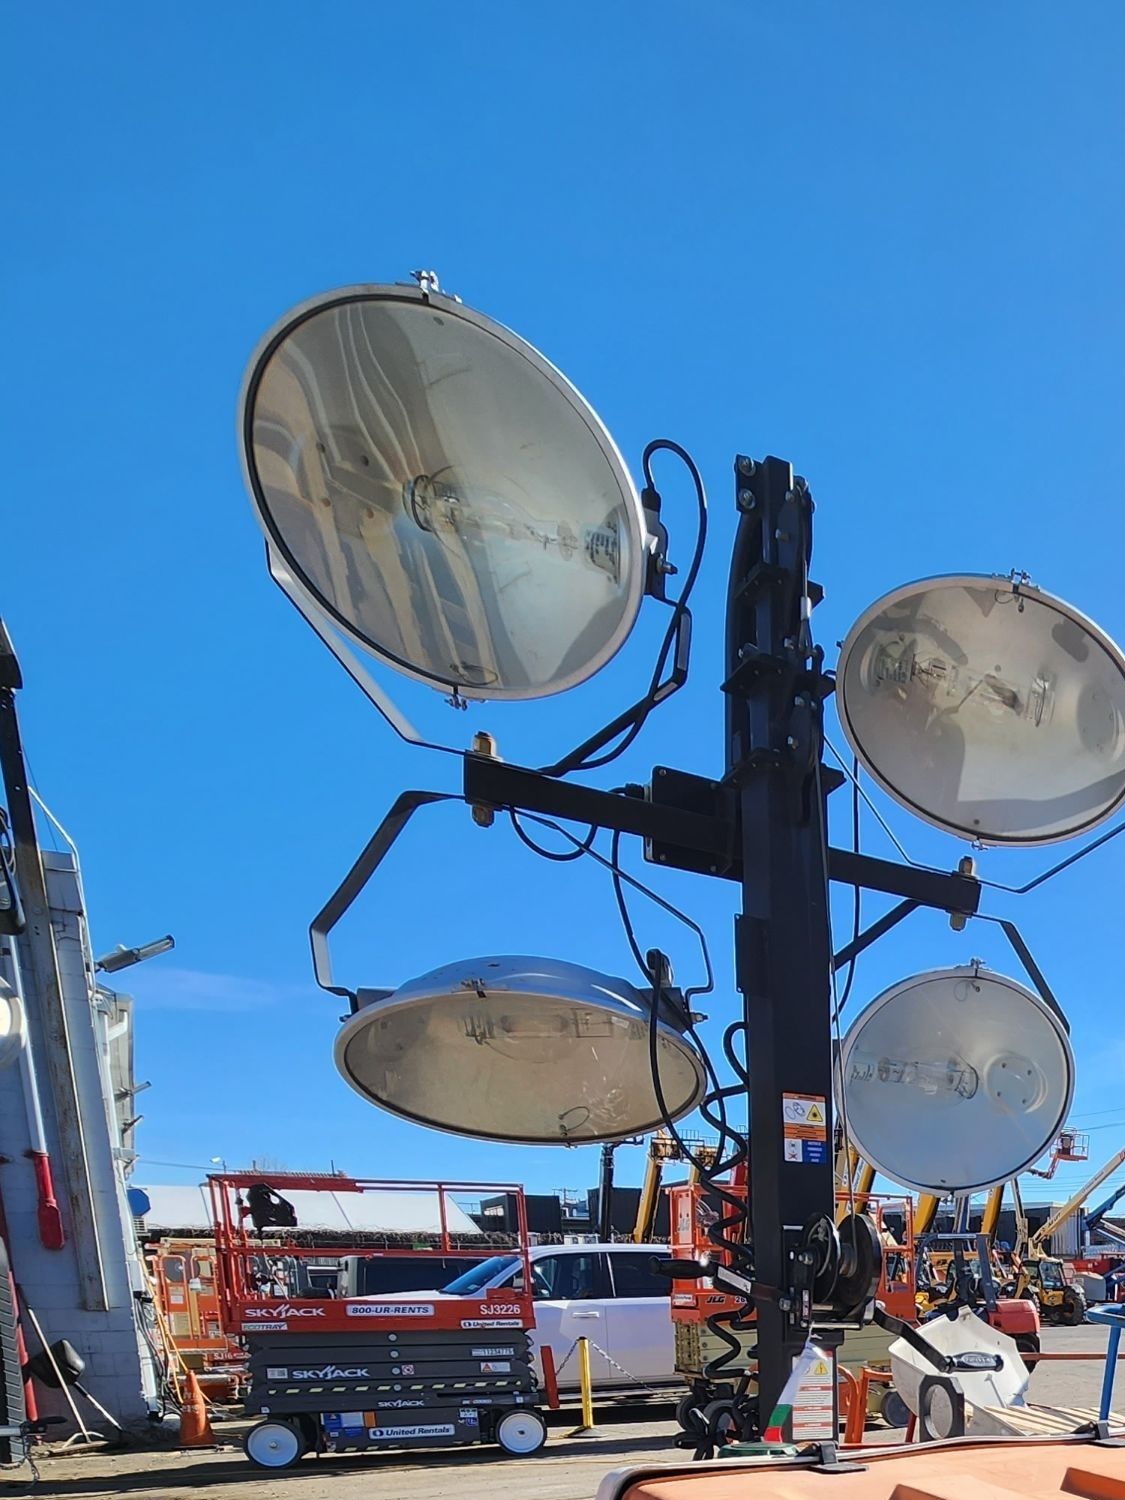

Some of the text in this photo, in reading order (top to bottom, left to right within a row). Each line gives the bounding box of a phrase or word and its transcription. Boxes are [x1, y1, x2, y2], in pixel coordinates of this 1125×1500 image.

[706, 1296, 726, 1304] JLG
[244, 1303, 327, 1318] SKYJACK
[351, 1306, 429, 1314] 800-UR-RENTS
[479, 1304, 521, 1315] SJ3226
[292, 1365, 370, 1379] SKYJACK
[385, 1426, 450, 1437] United Rentals
